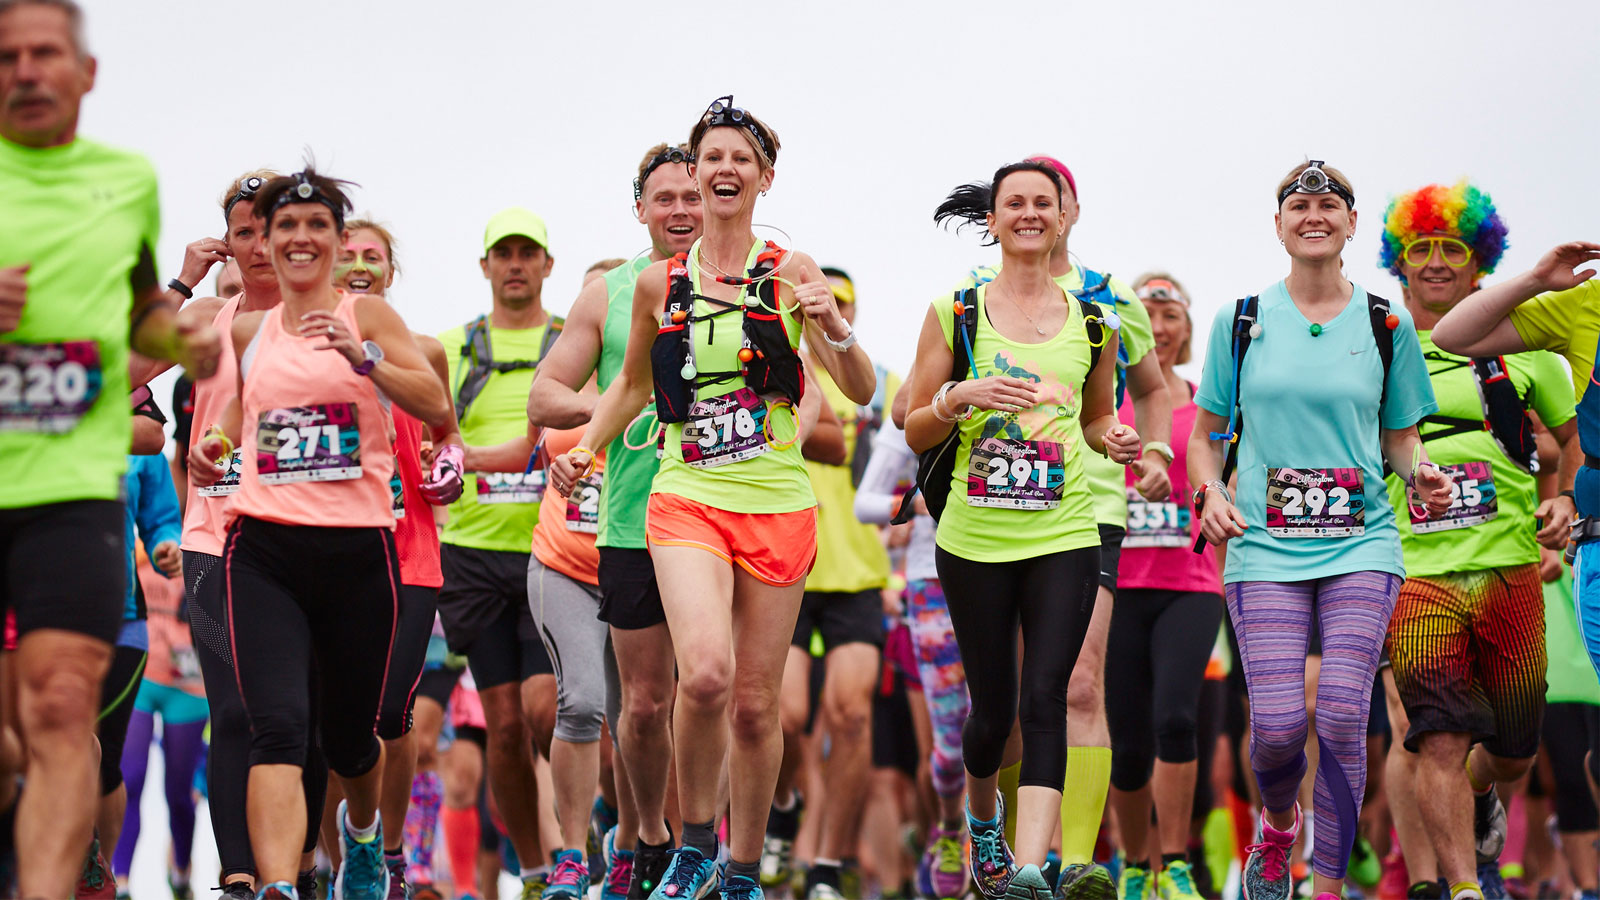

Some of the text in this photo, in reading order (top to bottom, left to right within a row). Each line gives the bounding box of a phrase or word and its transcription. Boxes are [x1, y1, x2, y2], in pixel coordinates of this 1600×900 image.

[0, 362, 87, 404] 220
[704, 398, 738, 416] Afterglow
[277, 424, 341, 460] 271
[695, 407, 756, 448] 378
[1001, 444, 1037, 459] Afterglow
[987, 456, 1048, 489] 291
[1297, 473, 1334, 487] Afterglow
[1128, 502, 1178, 529] 331
[1281, 486, 1350, 516] 292
